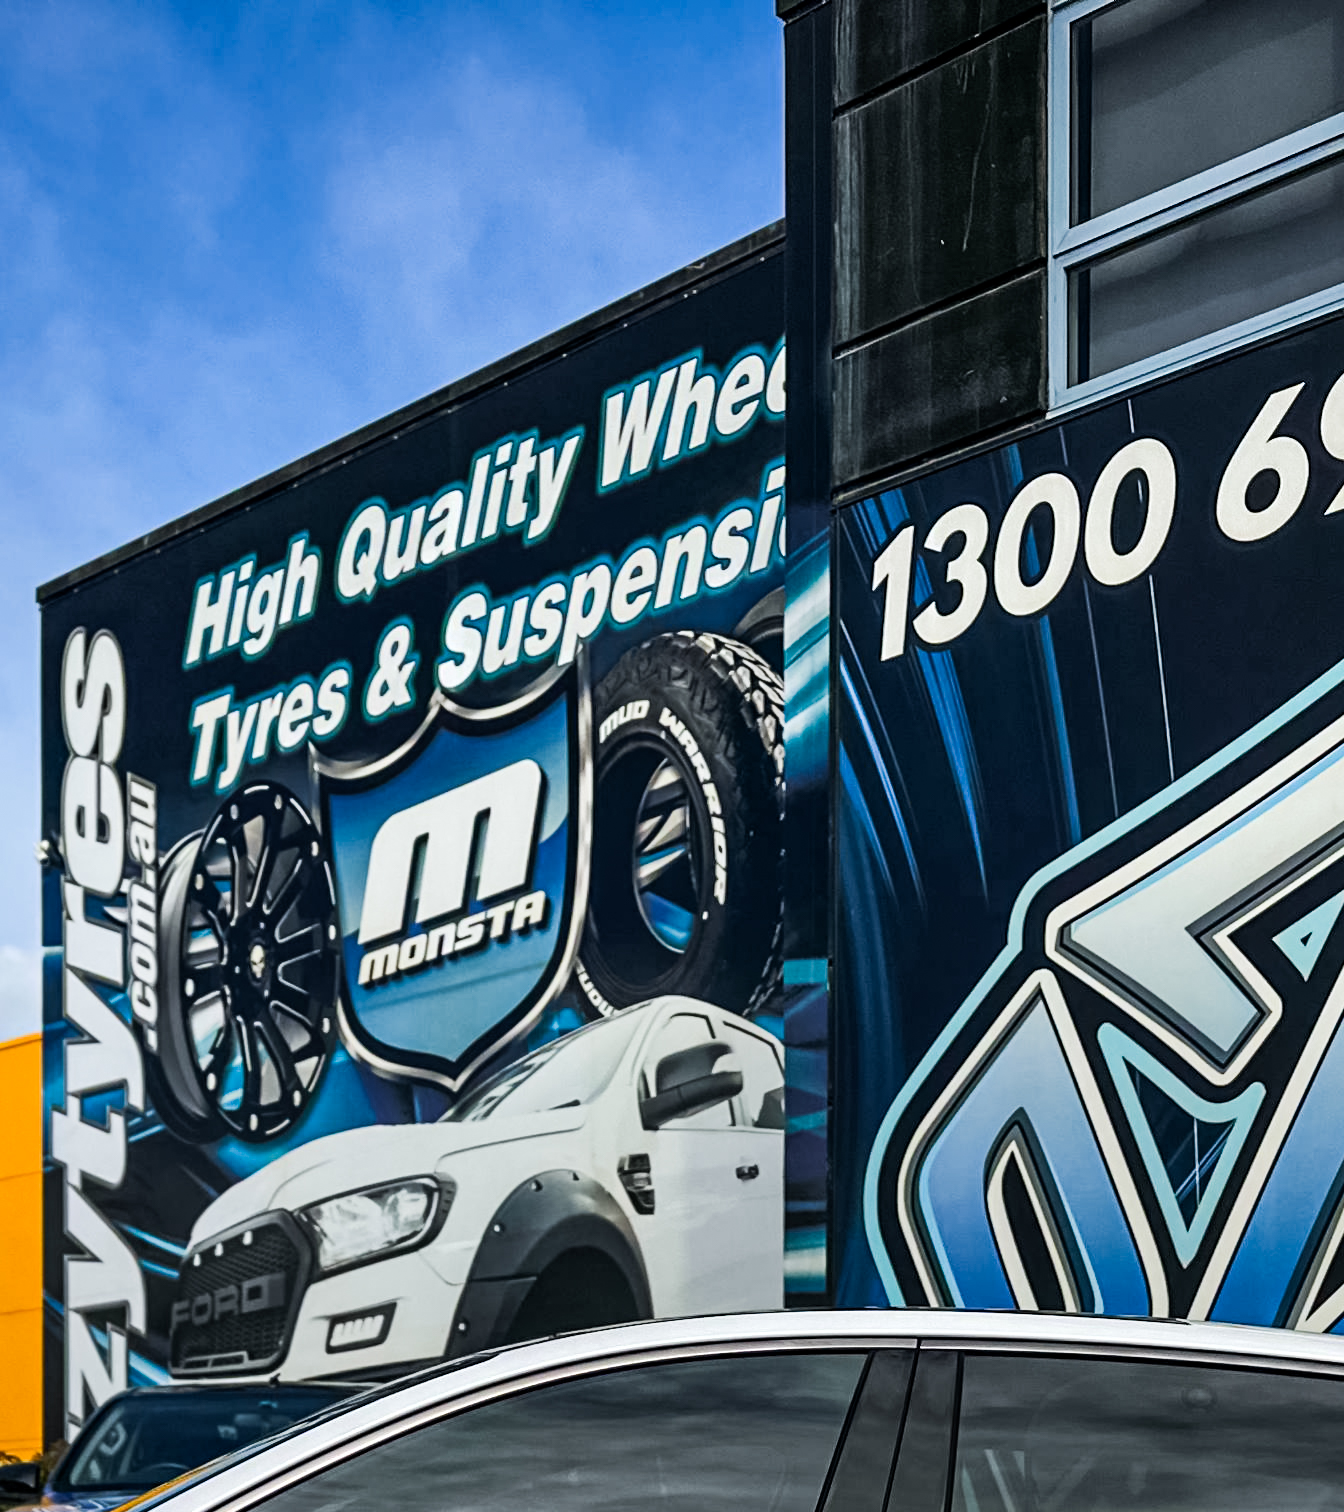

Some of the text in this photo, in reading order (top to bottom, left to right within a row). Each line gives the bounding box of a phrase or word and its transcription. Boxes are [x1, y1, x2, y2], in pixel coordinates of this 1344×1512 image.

[185, 538, 321, 667] High
[339, 435, 580, 598] Quality
[190, 465, 786, 788] Tyres & Suspensi
[871, 438, 1177, 662] 1300
[127, 772, 157, 1053] .com.au
[599, 700, 727, 905] MUD WARRIOR
[53, 628, 148, 1446] zytyres
[358, 890, 546, 986] MONSTA
[169, 1281, 271, 1336] FORD
